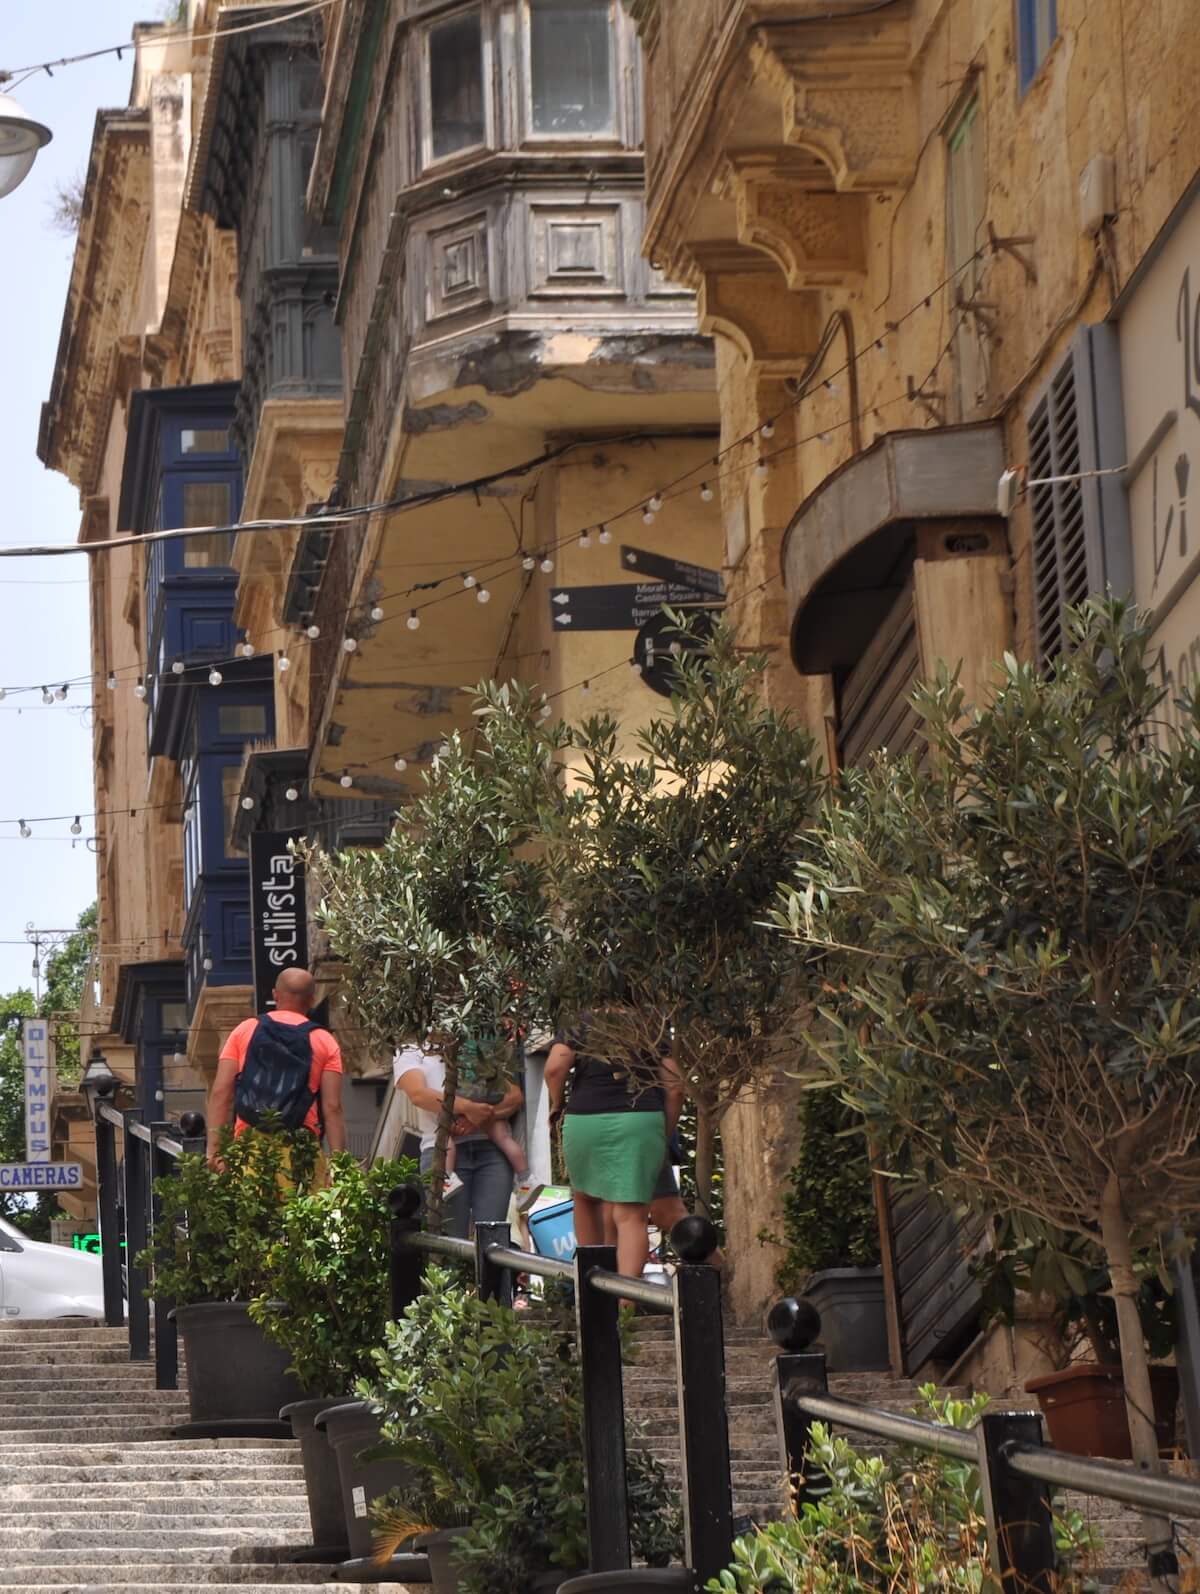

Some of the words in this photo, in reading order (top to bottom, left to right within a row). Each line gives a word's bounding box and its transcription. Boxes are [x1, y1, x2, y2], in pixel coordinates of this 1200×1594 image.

[262, 855, 297, 965] stilista
[28, 1028, 47, 1152] OLYMPUS
[0, 1167, 79, 1185] CAMERAS
